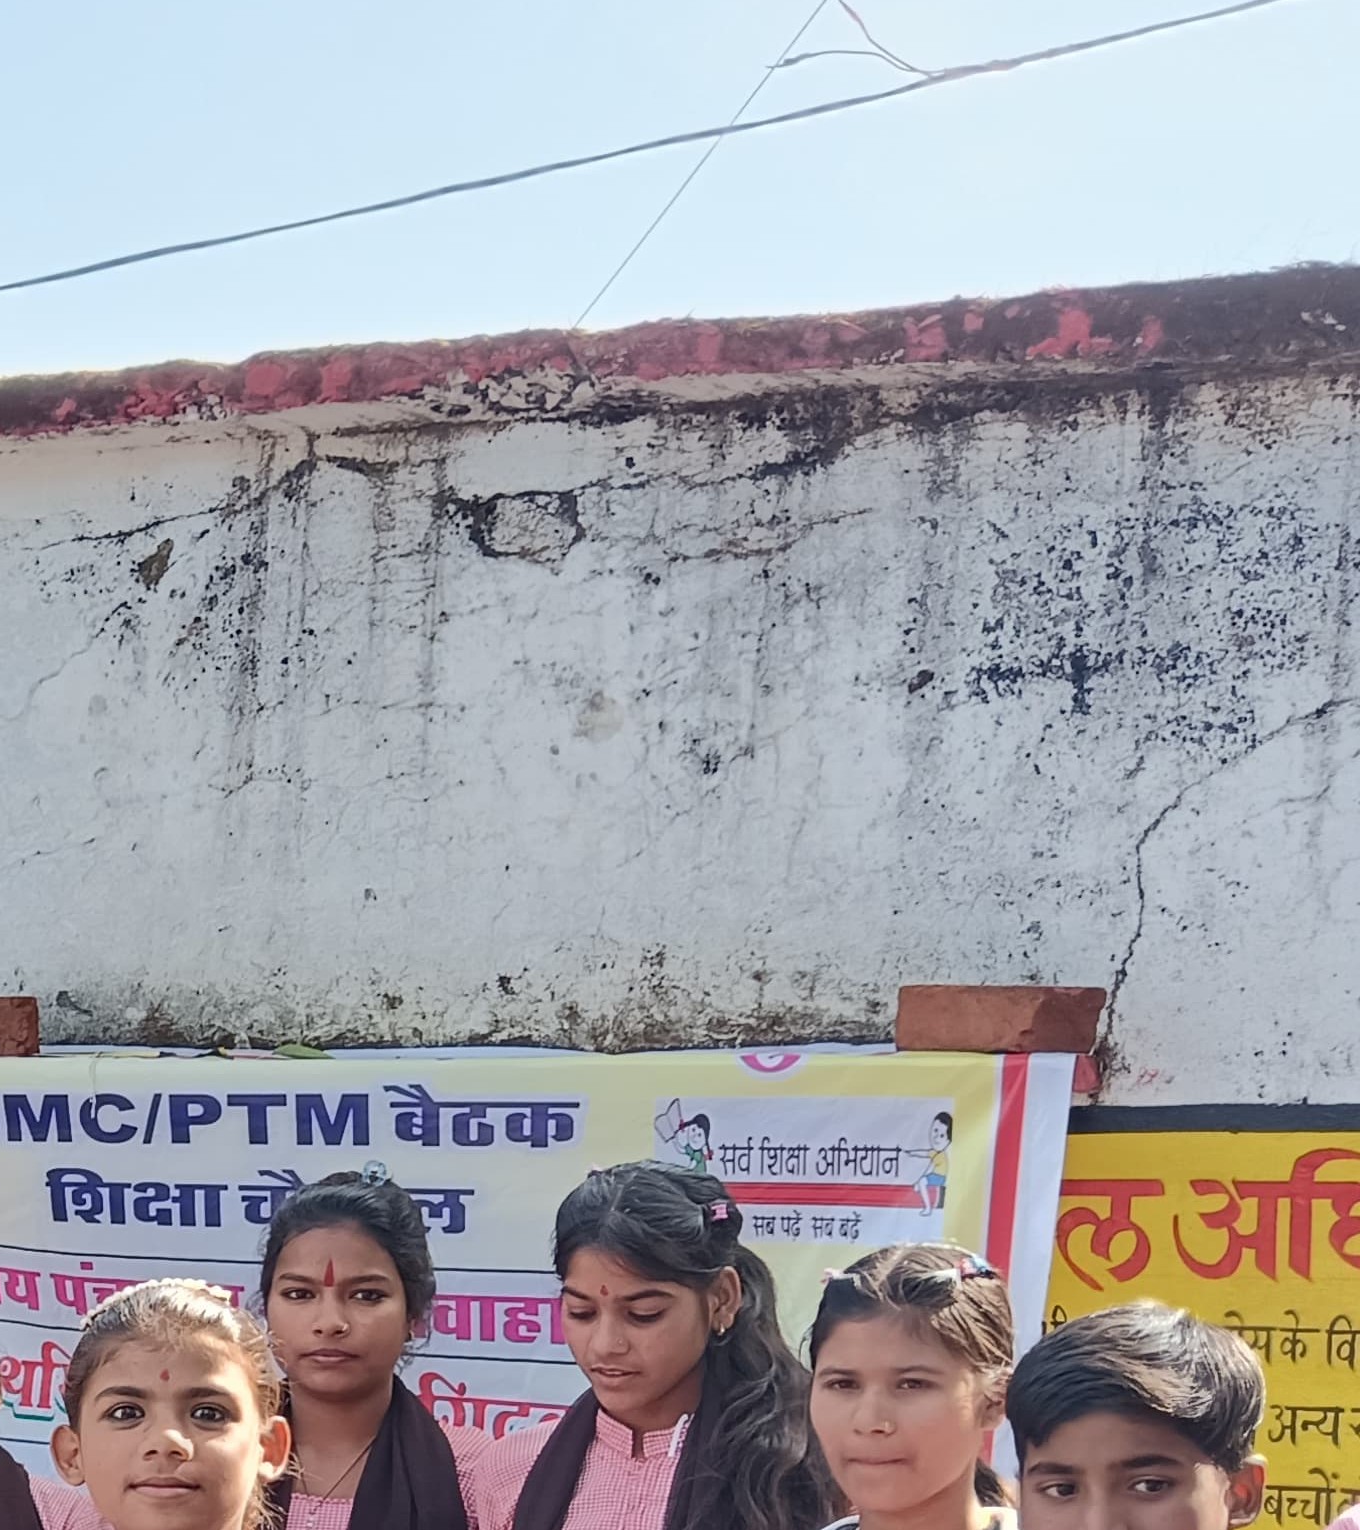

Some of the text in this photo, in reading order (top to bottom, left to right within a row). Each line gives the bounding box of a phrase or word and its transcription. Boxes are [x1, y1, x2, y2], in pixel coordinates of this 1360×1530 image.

[382, 1083, 581, 1148] बैठक
[718, 1136, 903, 1178] सर्व शिक्षा अभियान
[46, 1167, 228, 1228] शिक्षा
[752, 1215, 777, 1238] सब
[811, 1216, 836, 1238] सब
[1279, 1309, 1321, 1363] के
[1326, 1314, 1360, 1370] वि
[1267, 1404, 1344, 1447] अन्य
[1264, 1467, 1339, 1526] बच्चों
